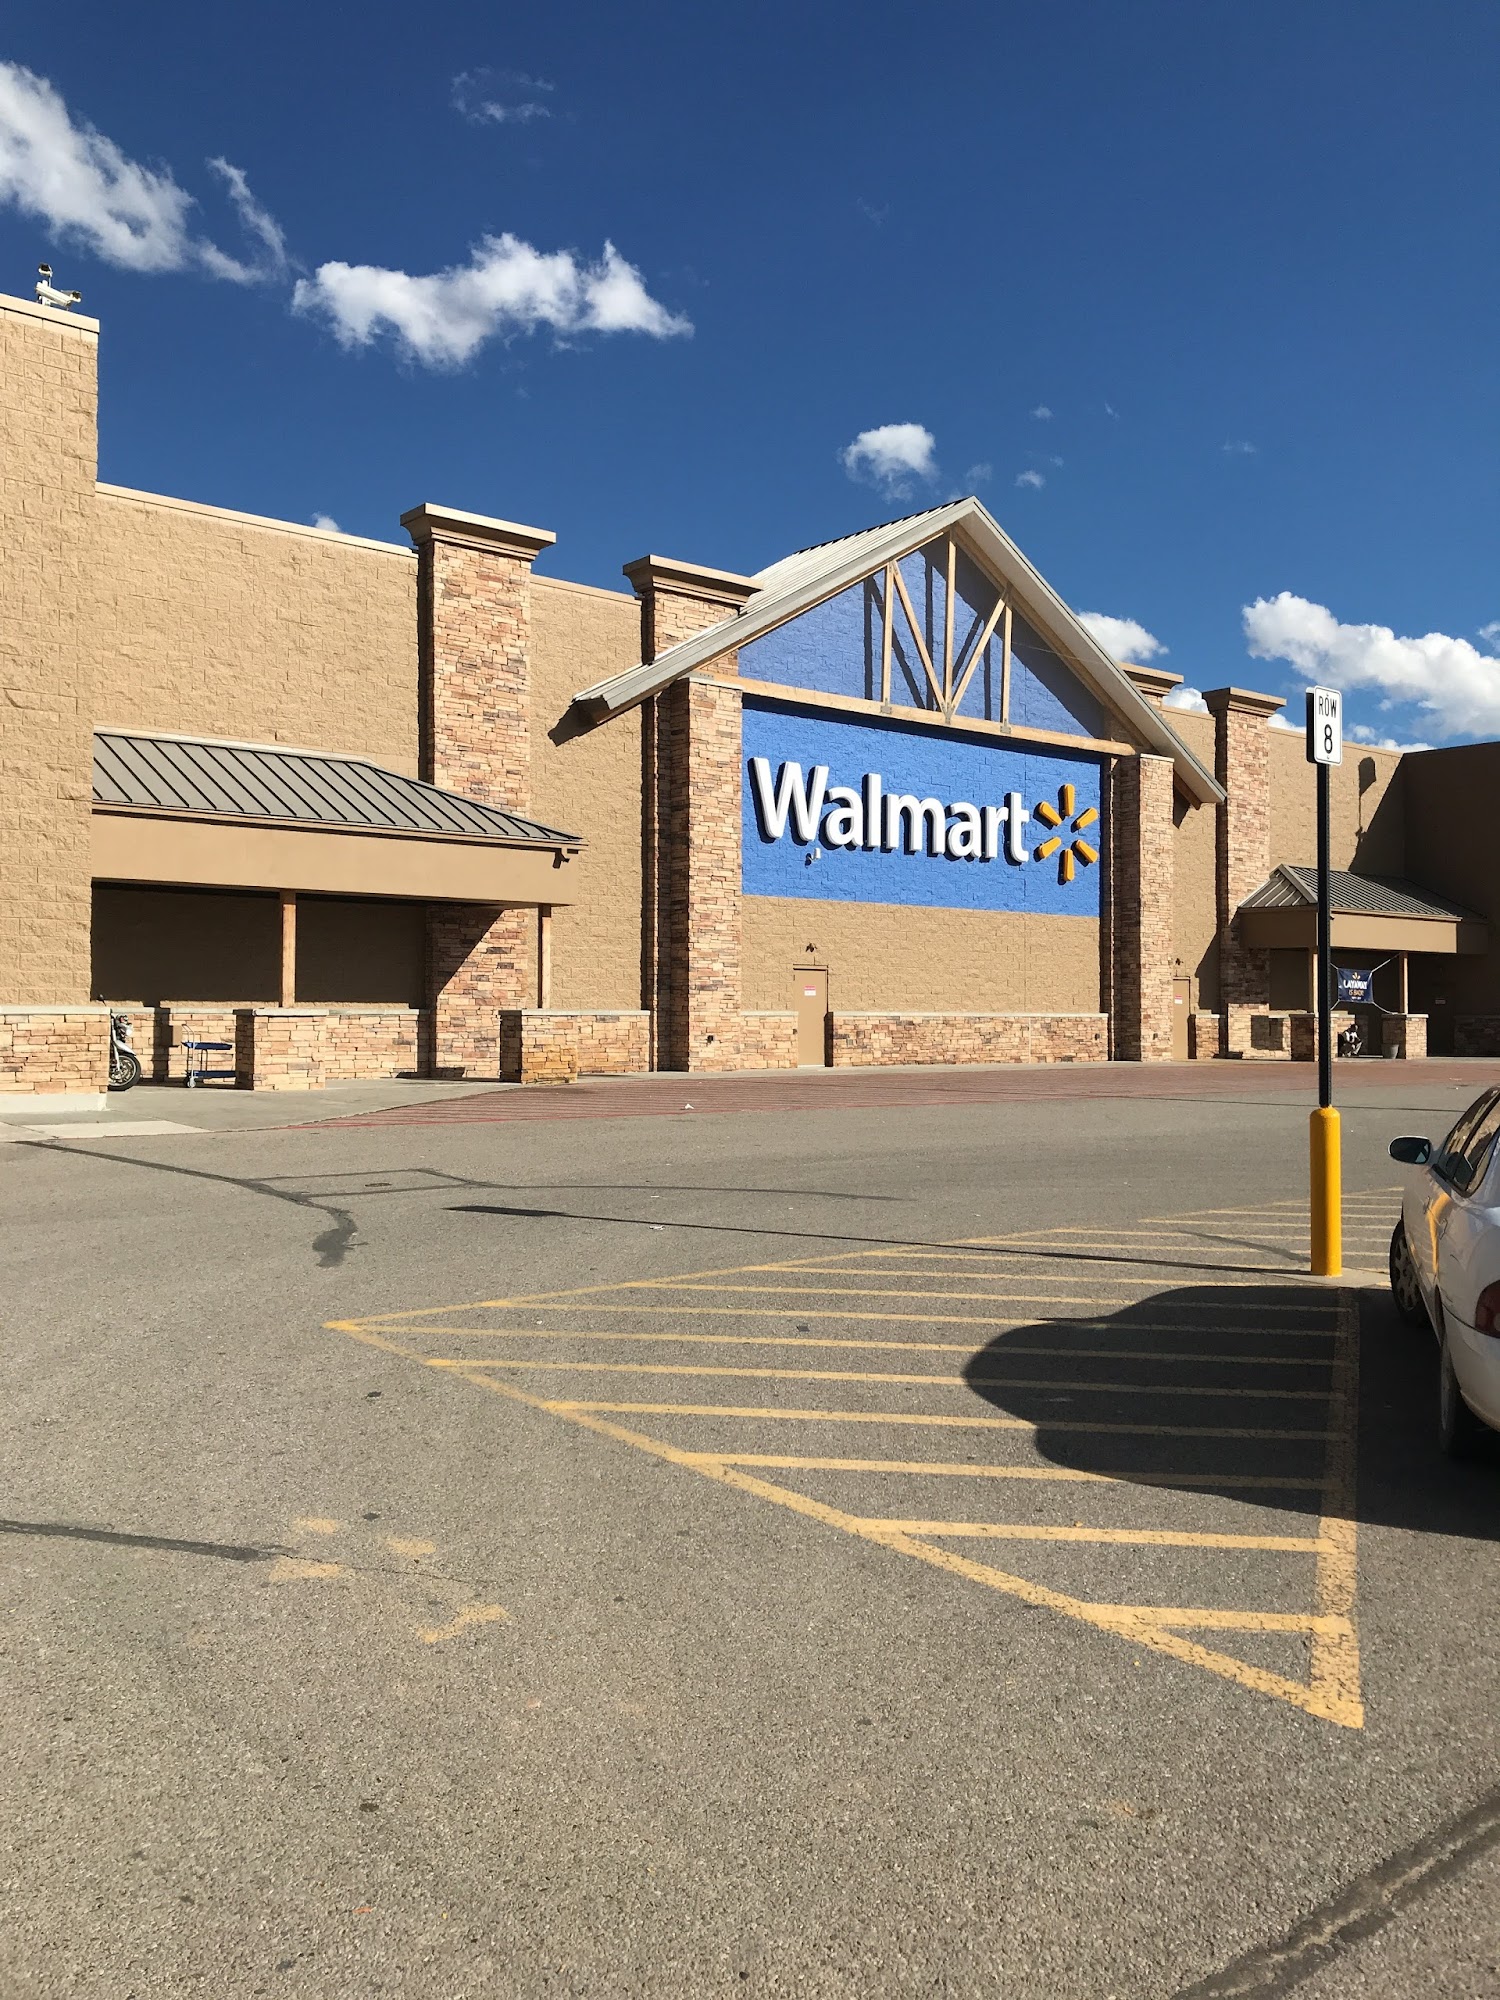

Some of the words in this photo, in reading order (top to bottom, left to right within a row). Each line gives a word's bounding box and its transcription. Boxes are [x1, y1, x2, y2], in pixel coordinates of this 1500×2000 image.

[1318, 696, 1337, 718] ROW
[1324, 724, 1333, 754] 8
[750, 757, 1029, 862] Walmart
[1343, 980, 1368, 989] LAYAWAY
